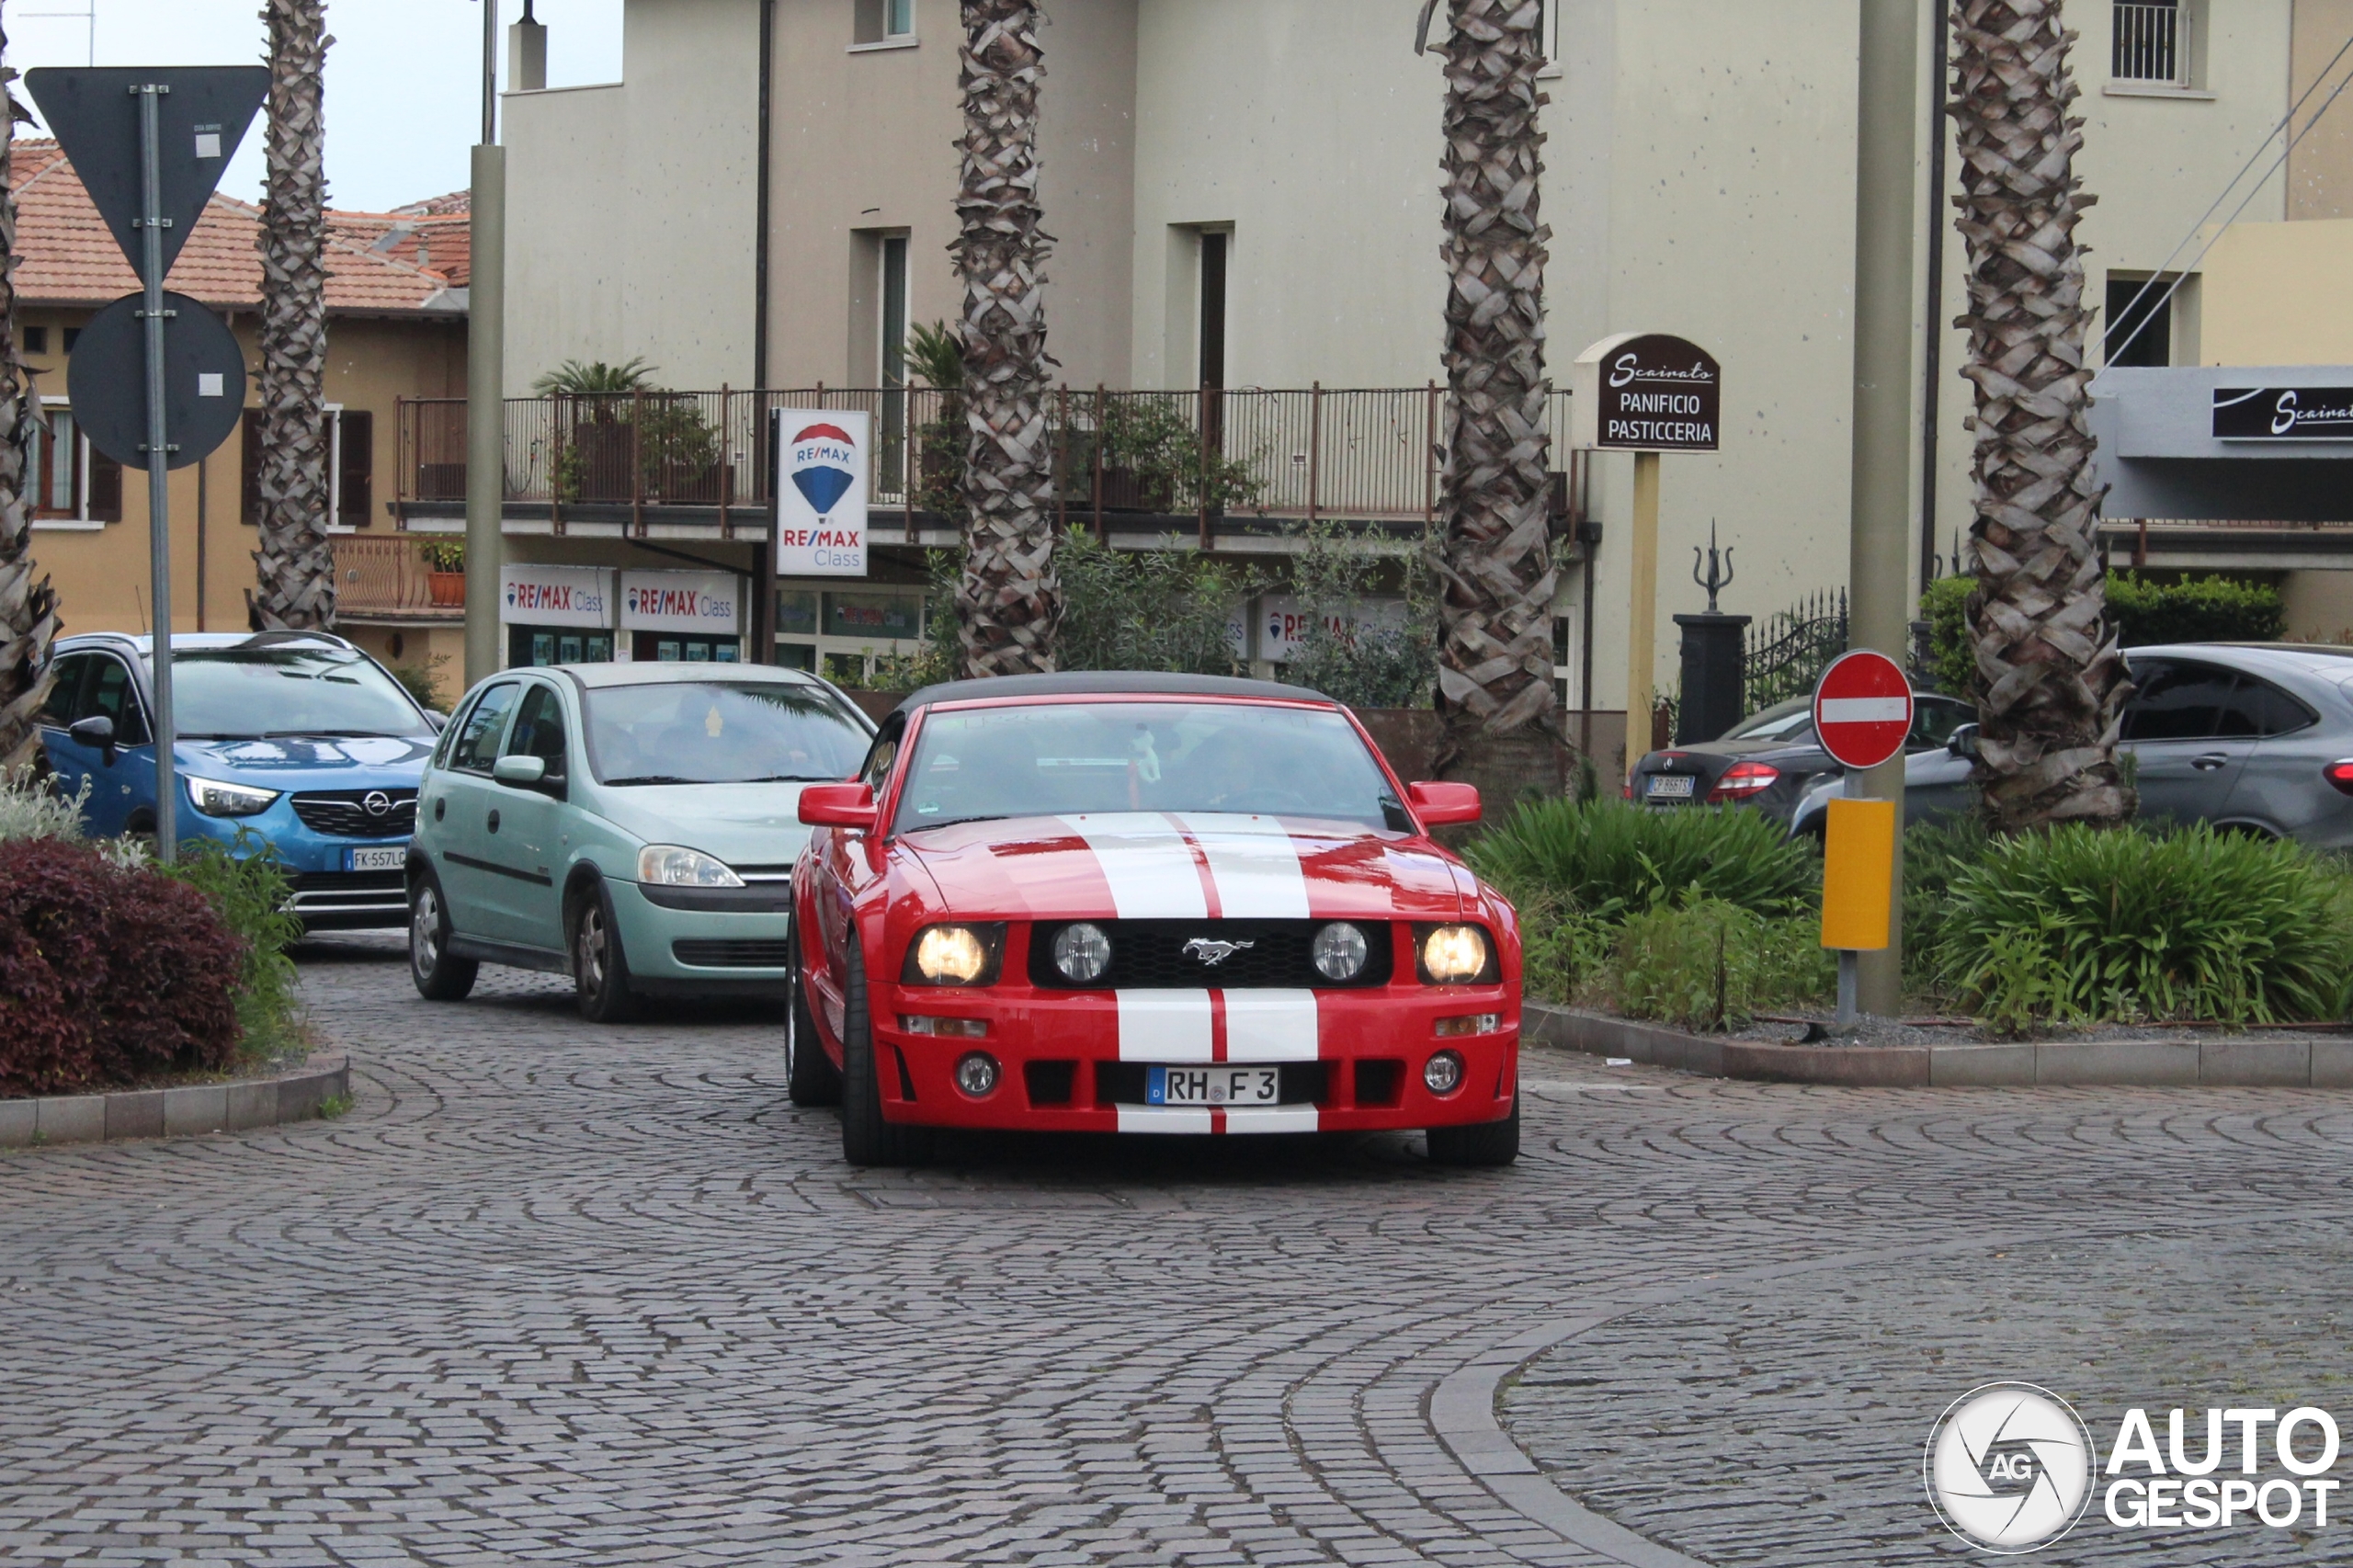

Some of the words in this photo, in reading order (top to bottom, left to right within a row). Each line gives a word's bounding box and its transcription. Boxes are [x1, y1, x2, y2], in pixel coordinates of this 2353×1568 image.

[1620, 393, 1700, 415] PANIFICIO
[1608, 420, 1711, 442] PASTICCERIA
[797, 447, 850, 464] RE/MAX
[784, 529, 859, 548] RE/MAX
[814, 550, 859, 566] Class
[517, 584, 571, 610] RE/MAX
[574, 591, 603, 612] Class
[640, 589, 697, 617] RE/MAX
[701, 596, 732, 618] Class
[1153, 1089, 1160, 1098] D
[1167, 1072, 1208, 1100] RH
[1230, 1072, 1249, 1100] F
[1256, 1072, 1276, 1100] 3
